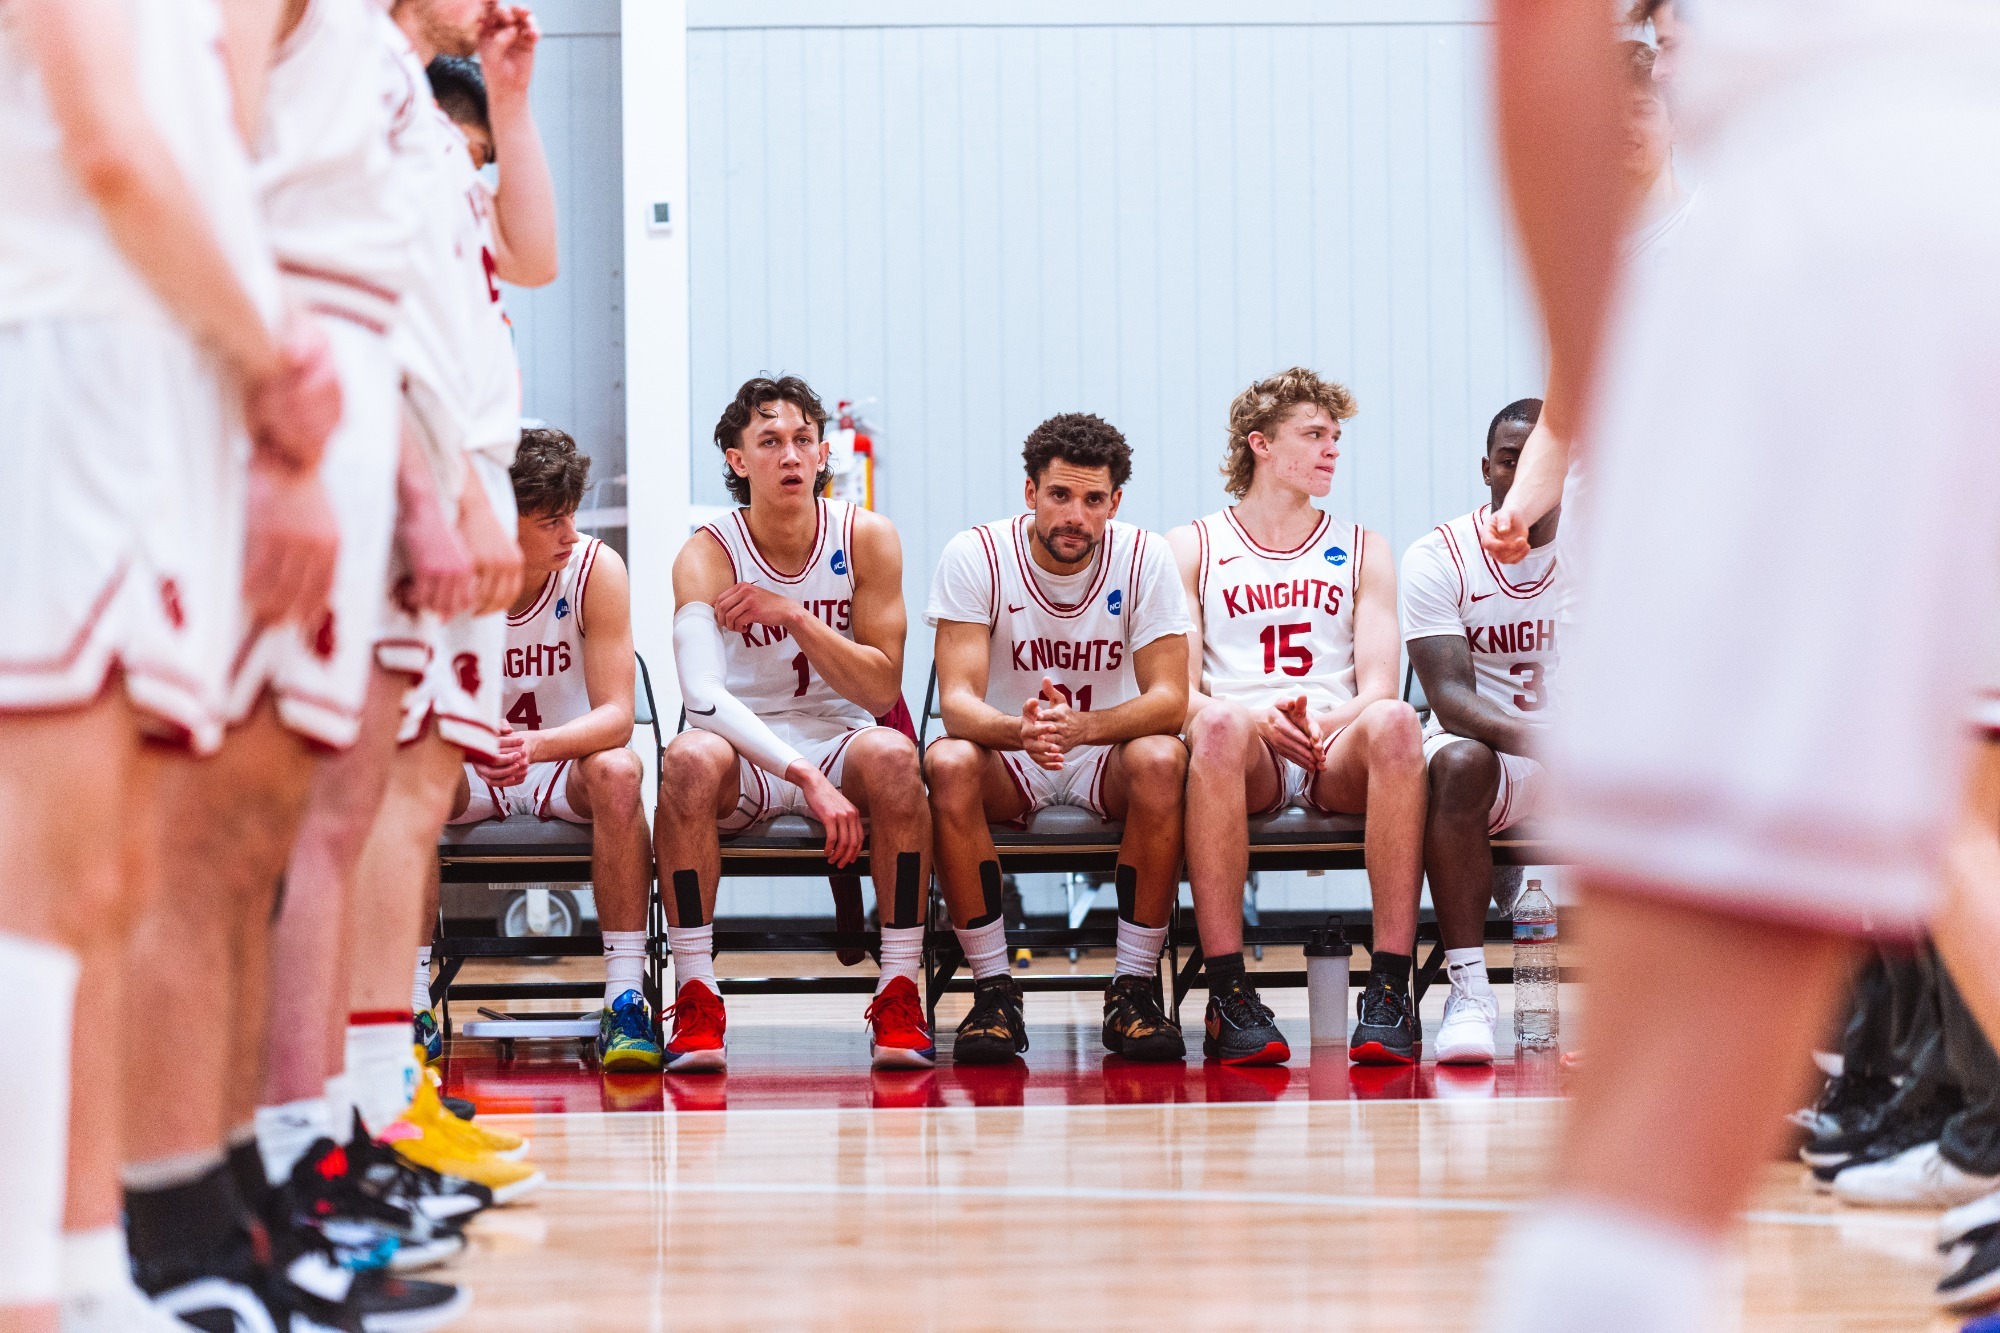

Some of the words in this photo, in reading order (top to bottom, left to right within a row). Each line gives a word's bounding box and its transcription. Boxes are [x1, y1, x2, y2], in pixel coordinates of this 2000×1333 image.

[1222, 579, 1344, 618] KNIGHTS
[1011, 637, 1124, 671] KNIGHTS
[1259, 622, 1313, 676] 15
[1465, 619, 1555, 653] KNIGH
[502, 641, 571, 678] GHTS
[791, 651, 810, 697] 1
[1509, 661, 1548, 712] 3
[506, 691, 543, 730] 4
